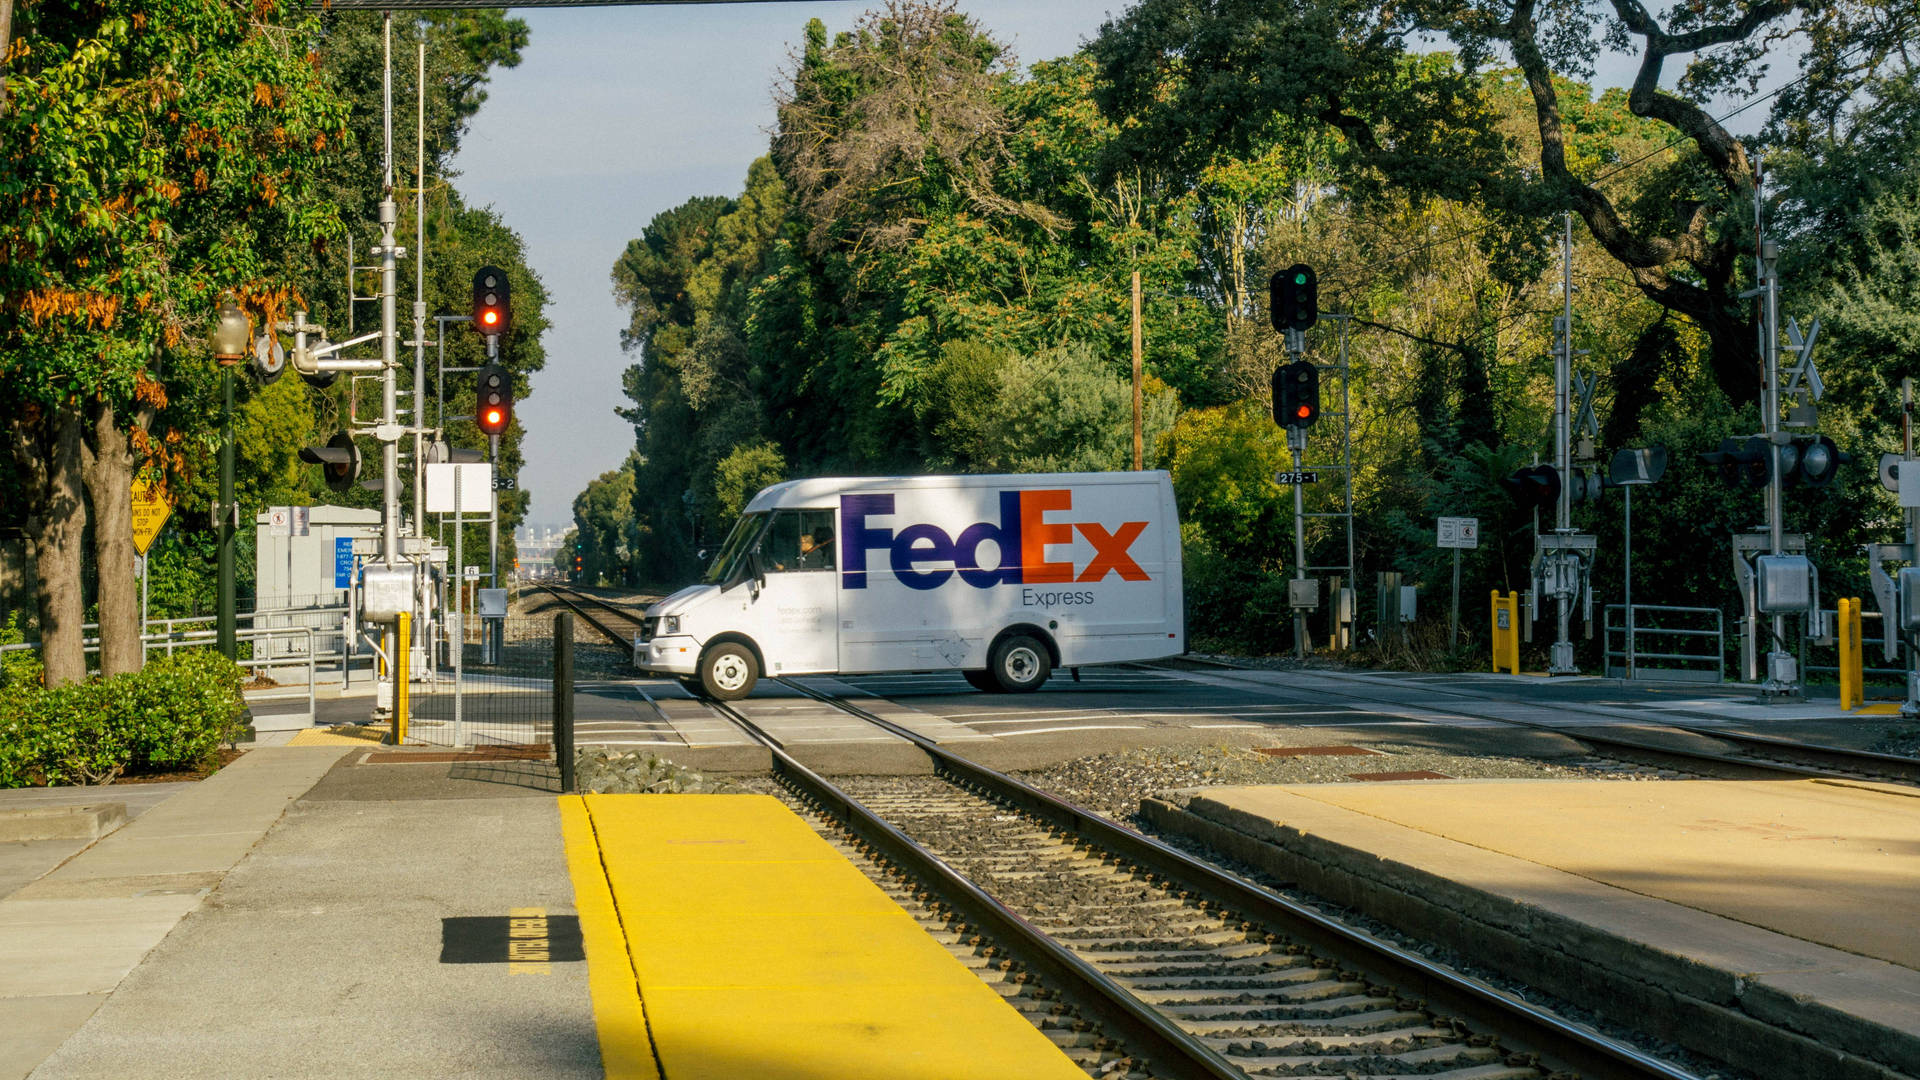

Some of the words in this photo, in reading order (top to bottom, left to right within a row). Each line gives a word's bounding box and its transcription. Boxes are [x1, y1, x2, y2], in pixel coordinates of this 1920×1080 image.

[1280, 473, 1317, 483] 275-1
[491, 478, 514, 489] 5-2
[136, 518, 149, 527] STOP
[840, 489, 1152, 591] FedEx
[468, 566, 475, 576] 6
[1022, 588, 1095, 609] Express
